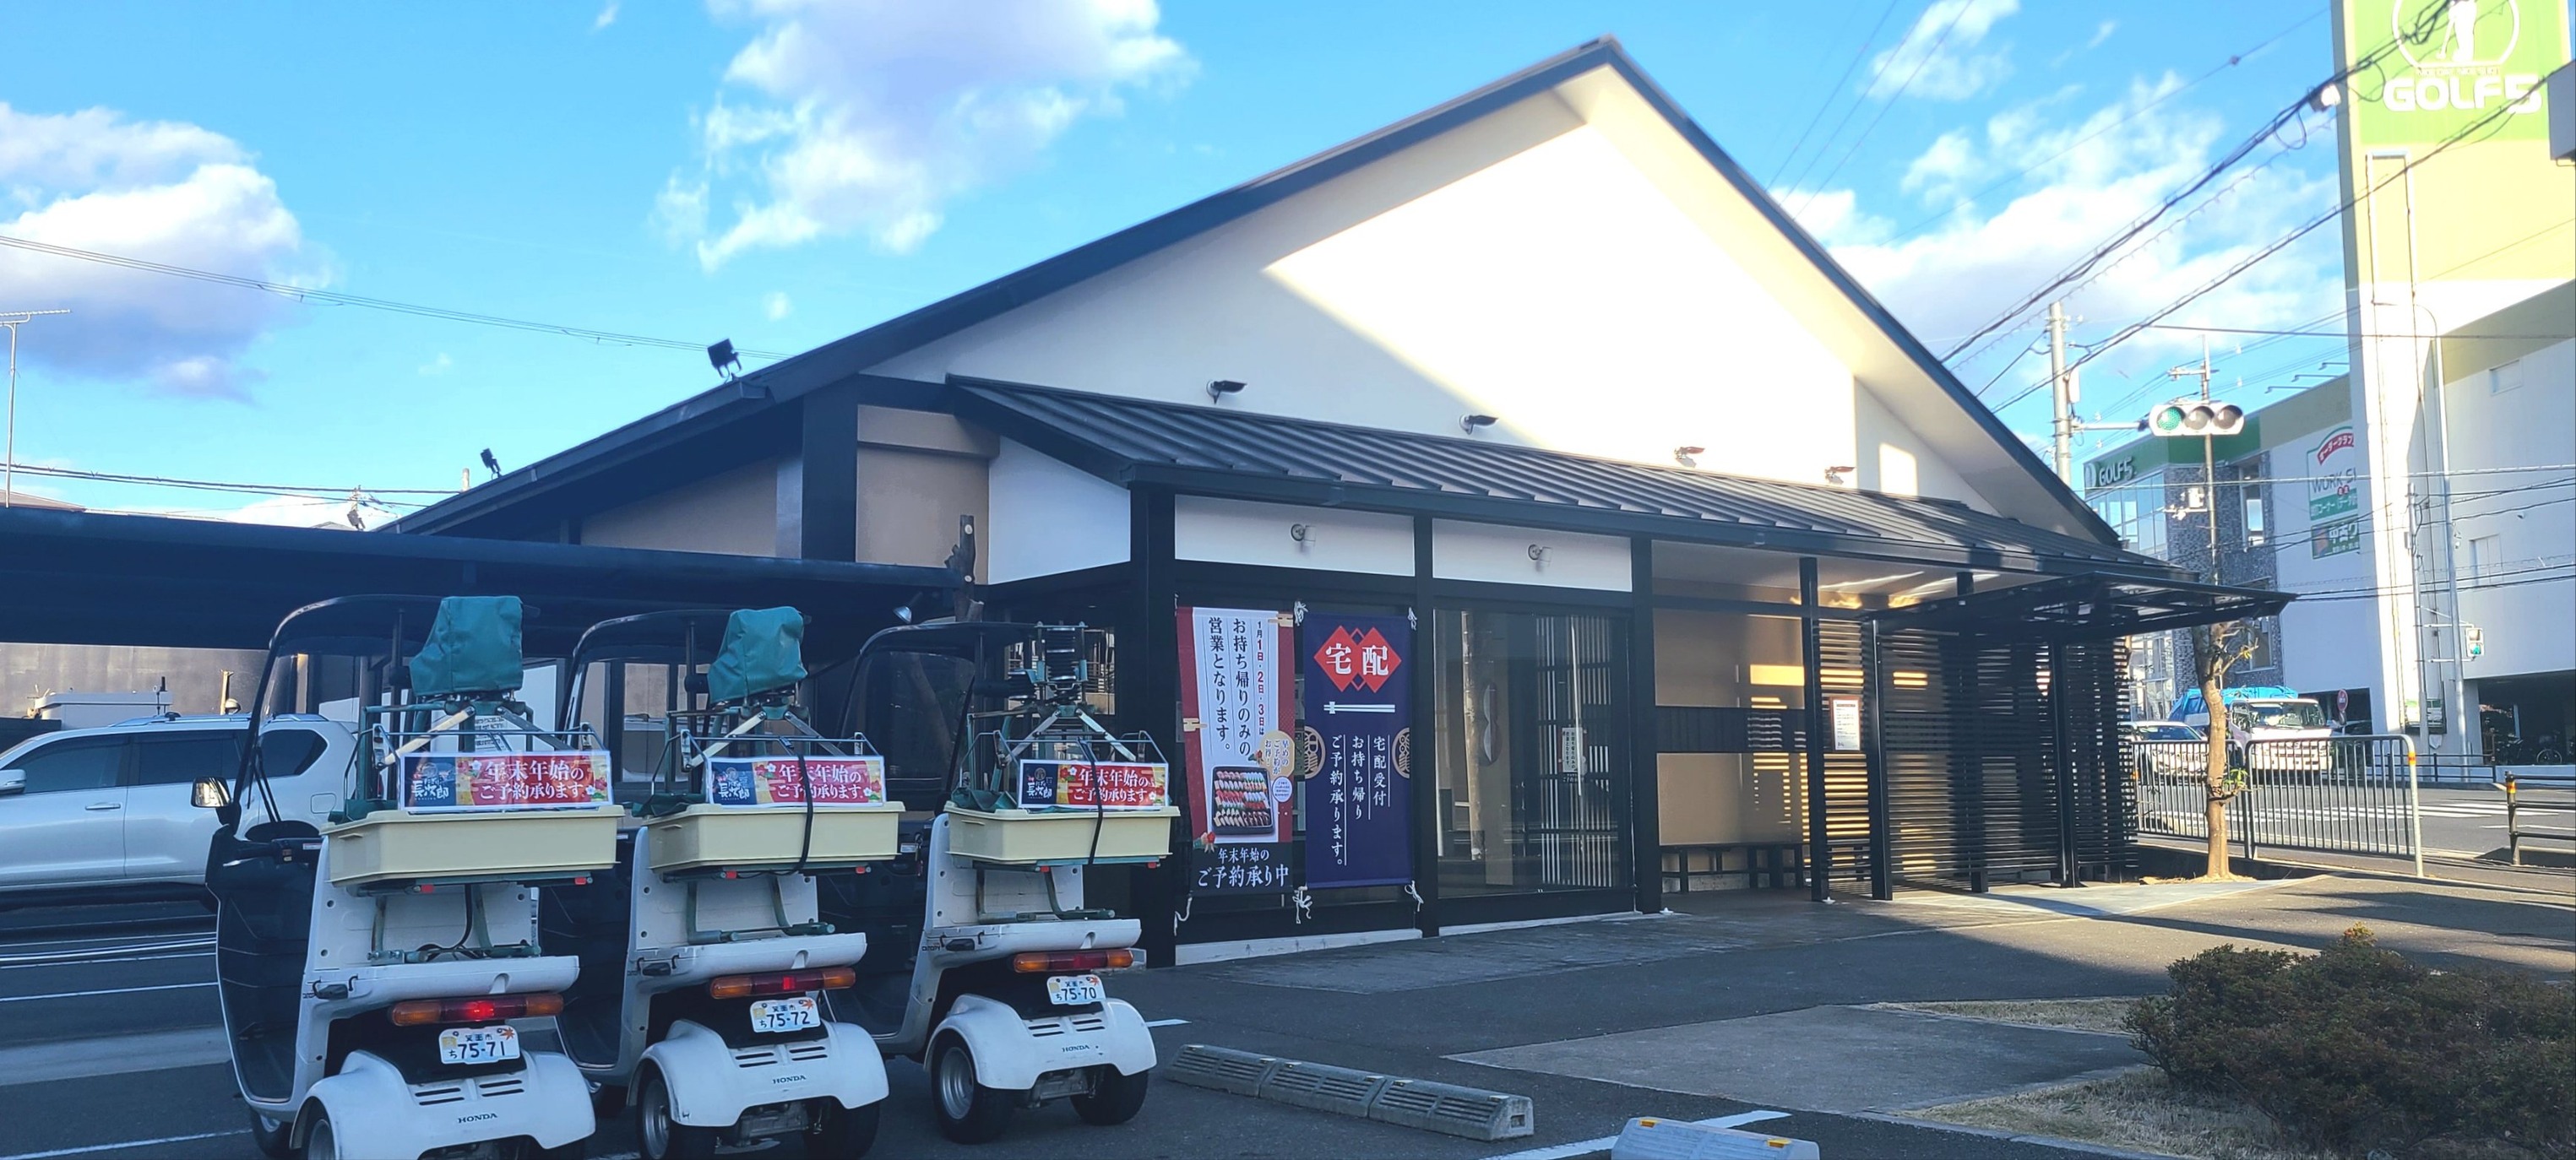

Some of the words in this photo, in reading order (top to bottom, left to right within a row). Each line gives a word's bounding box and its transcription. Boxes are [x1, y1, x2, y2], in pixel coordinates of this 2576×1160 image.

[2099, 456, 2133, 486] GOLF5
[2312, 470, 2343, 494] WORK
[1325, 643, 1389, 676] 宅配
[1209, 617, 1231, 750] 営業となります。
[1233, 618, 1252, 756] お持ち帰りのみの
[485, 760, 584, 783] 年末年始の
[1078, 768, 1149, 788] 年末年始の
[1351, 735, 1366, 820] お持ち帰り
[1372, 735, 1387, 806] 宅配受付
[1329, 734, 1345, 865] ご予約承ります。
[1218, 847, 1269, 864] 年末年始の
[1198, 864, 1289, 889] ご予約承り中
[1061, 987, 1096, 1001] 75-70
[759, 1020, 767, 1028] ち
[766, 1011, 810, 1028] 75-72
[448, 1049, 458, 1059] ち
[458, 1041, 506, 1060] 75-71
[1062, 1044, 1090, 1053] HONDA
[772, 1075, 807, 1084] HONDA
[458, 1113, 498, 1124] HONDA
